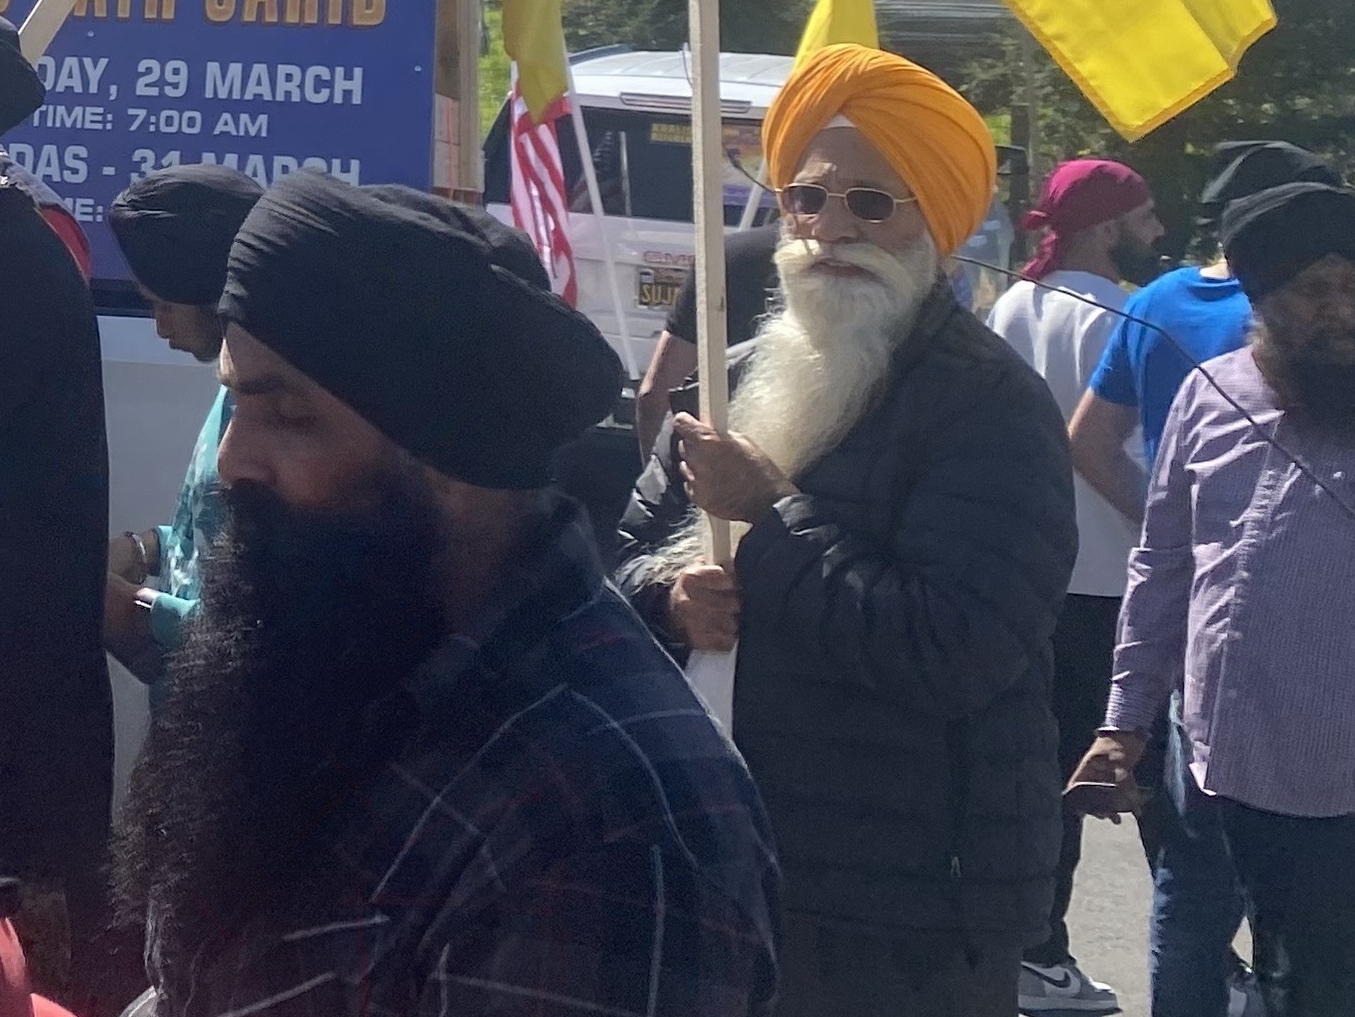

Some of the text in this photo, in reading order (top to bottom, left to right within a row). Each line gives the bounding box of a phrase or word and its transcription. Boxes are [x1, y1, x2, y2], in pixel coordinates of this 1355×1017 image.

[136, 59, 189, 97] 29
[205, 61, 363, 105] MARCH
[32, 105, 268, 137] TIME: 7:00 AM
[201, 152, 360, 188] ARH
[643, 250, 695, 266] GM
